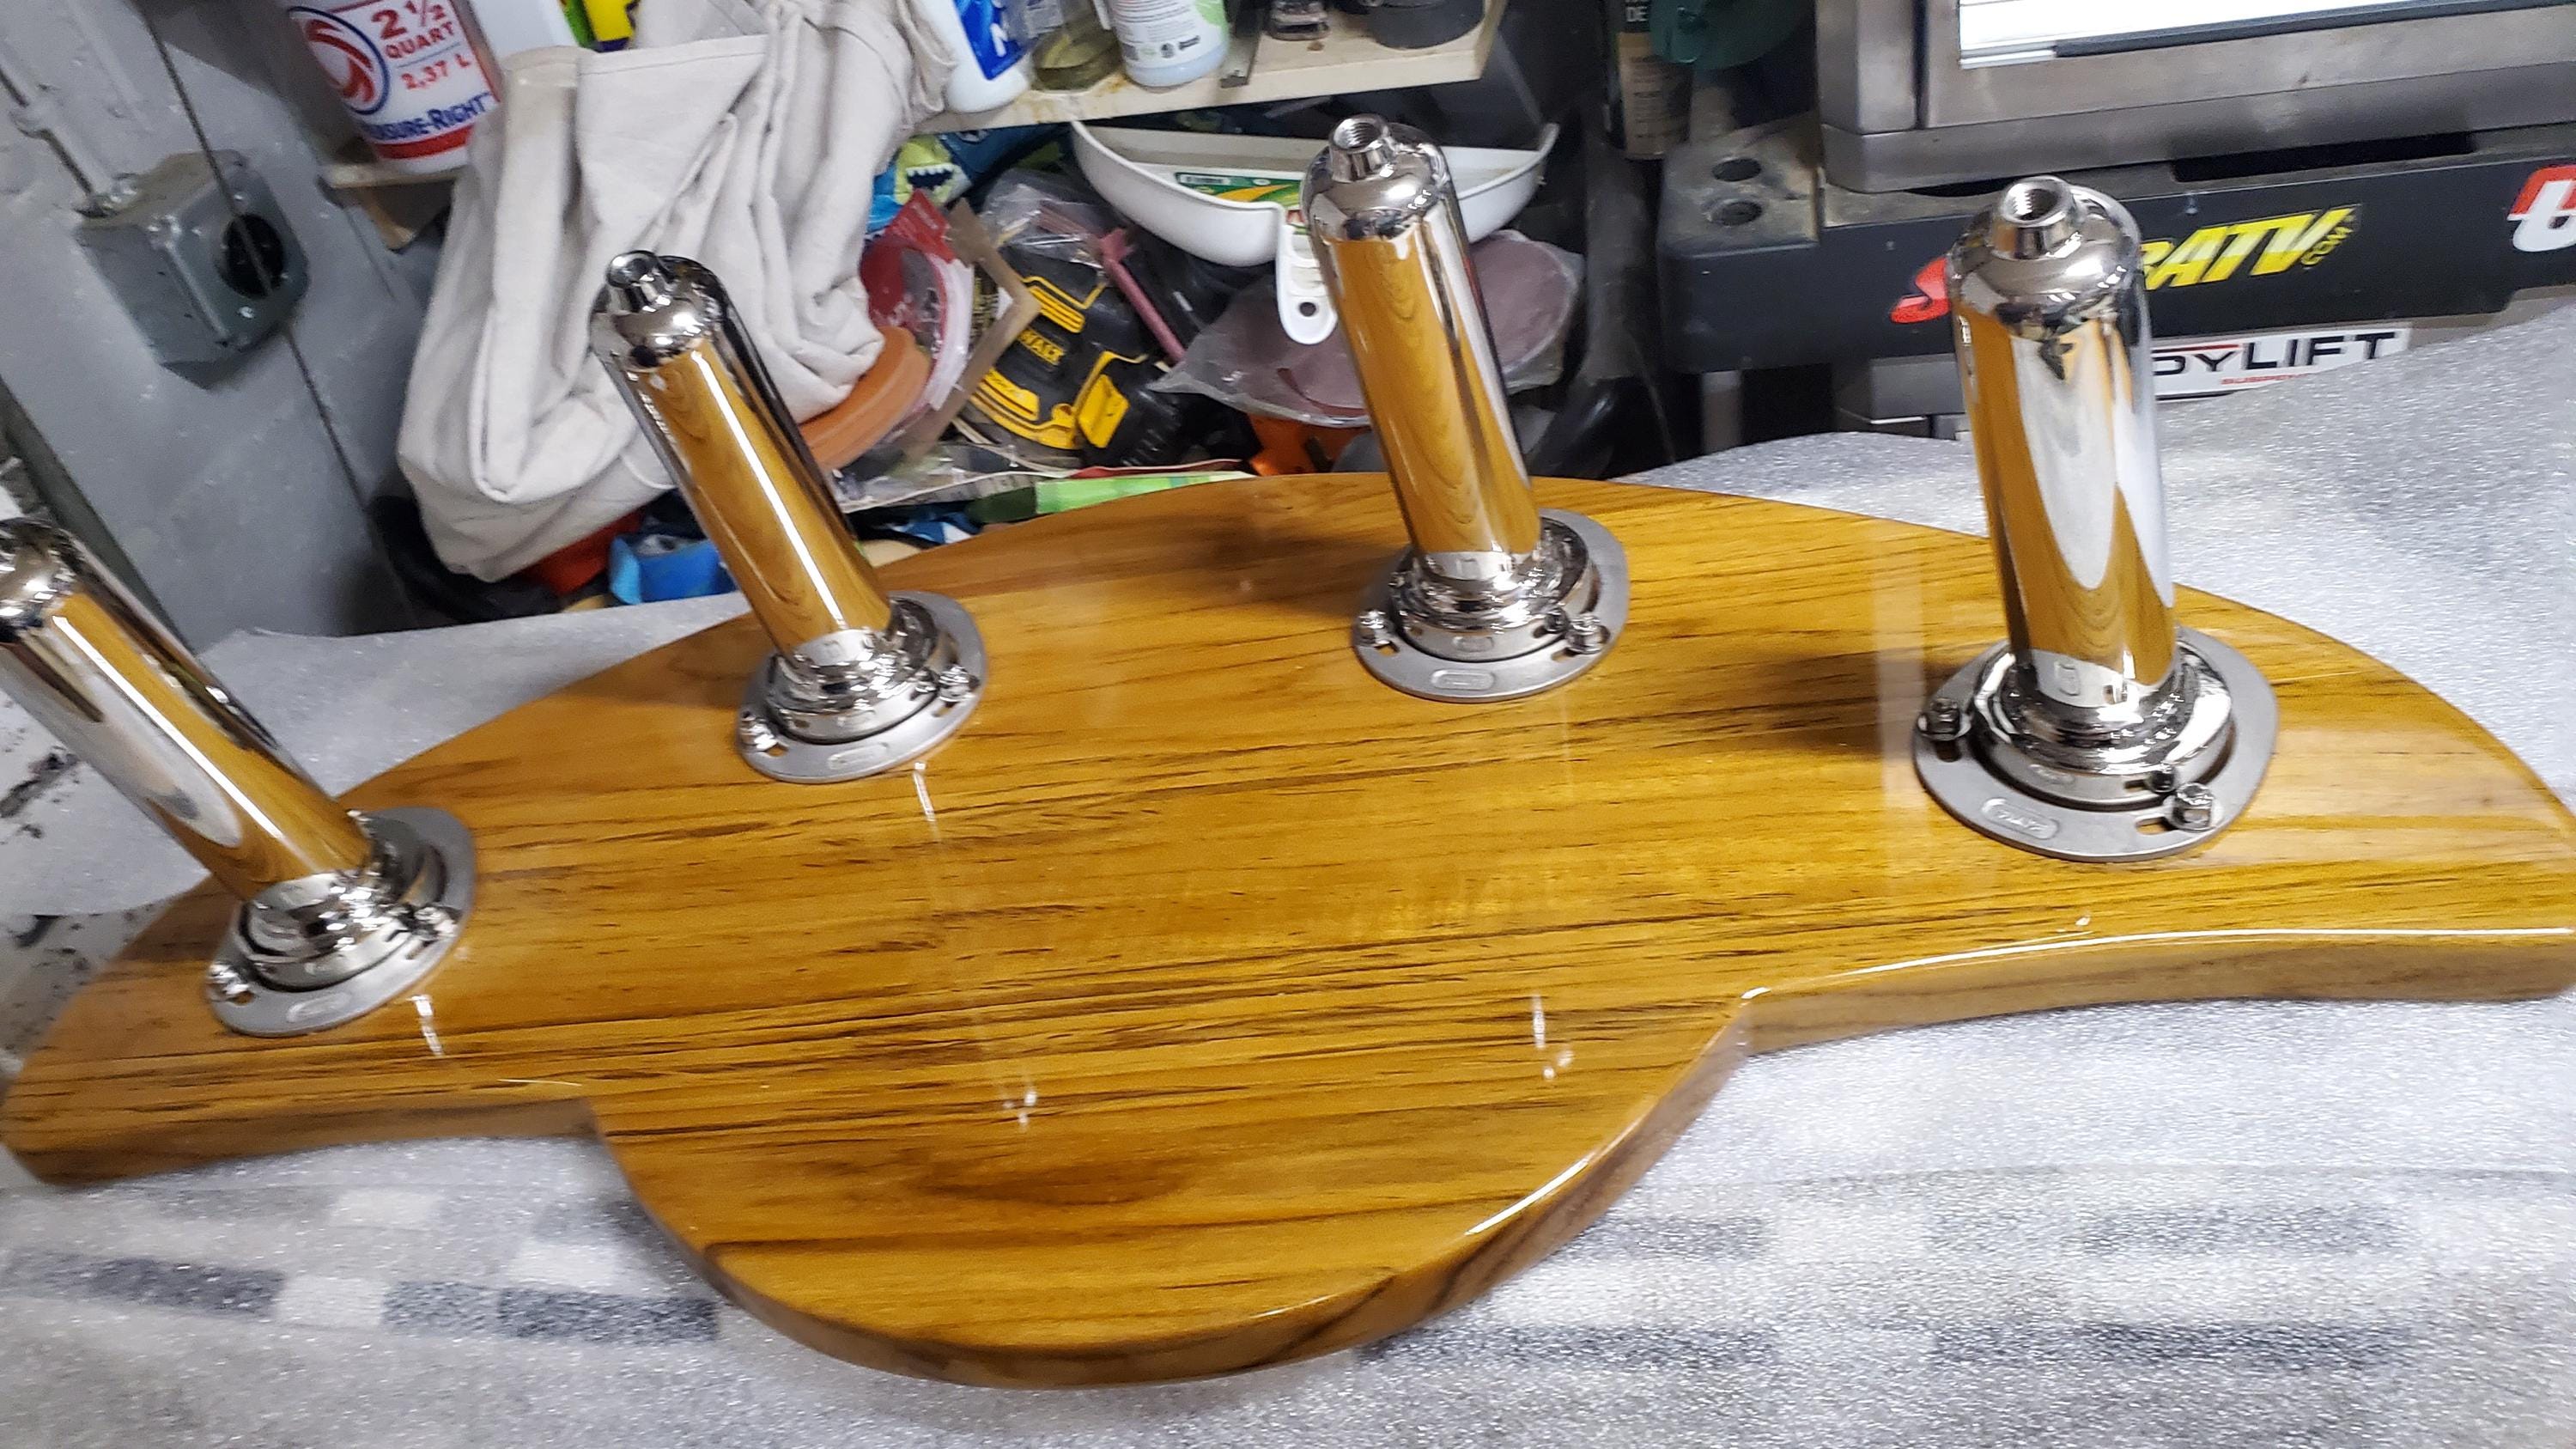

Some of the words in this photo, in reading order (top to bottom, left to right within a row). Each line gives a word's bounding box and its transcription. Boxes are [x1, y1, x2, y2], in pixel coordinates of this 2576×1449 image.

[371, 9, 408, 40] 2
[386, 21, 454, 58] QUART
[454, 52, 471, 68] L
[2151, 332, 2396, 375] DYLIFT
